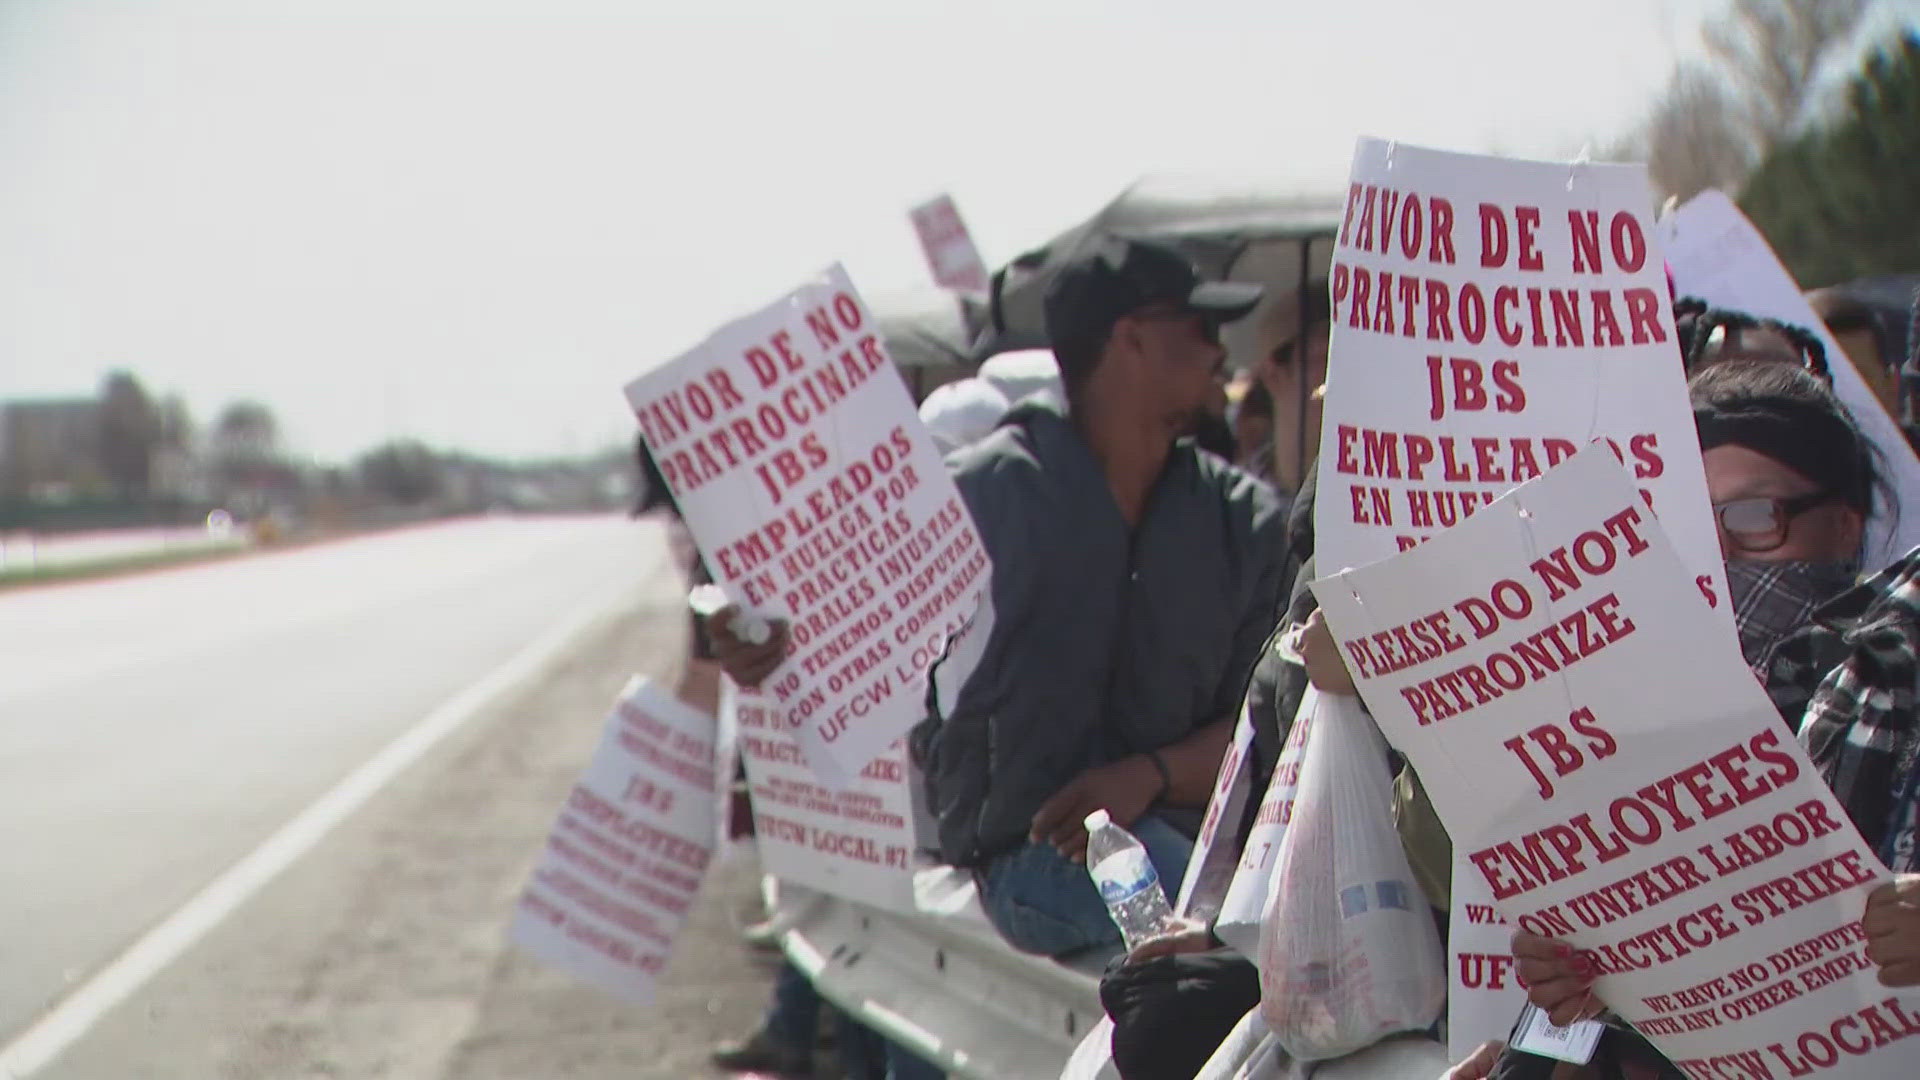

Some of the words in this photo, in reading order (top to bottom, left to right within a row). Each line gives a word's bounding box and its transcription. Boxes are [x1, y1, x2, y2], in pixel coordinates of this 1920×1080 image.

[1341, 182, 1455, 265] FAVOR
[1479, 203, 1544, 272] DE
[1567, 209, 1648, 276] NO
[744, 329, 806, 391] DE
[804, 291, 863, 351] NO
[1332, 262, 1668, 348] PRATROCINAR
[660, 333, 885, 498] PRATROCINAR
[1427, 356, 1527, 421] JBS
[715, 424, 913, 583] EMPLEADOS
[754, 431, 829, 506] JBS
[1336, 424, 1664, 482] EMPLEADS
[742, 570, 777, 607] EN
[781, 502, 873, 583] HUELGA
[874, 464, 919, 513] POR
[1351, 485, 1393, 526] EN
[784, 508, 912, 616] PRACTICAS
[785, 575, 876, 658] ORALES
[875, 498, 962, 587] INJUSTAS
[1343, 608, 1467, 680] PLEASE
[1456, 578, 1533, 640] DO
[1530, 505, 1650, 602] NOT
[773, 671, 800, 703] NO
[801, 602, 893, 676] TENEMOS
[895, 526, 973, 609] DISPUTAS
[788, 686, 825, 728] CON
[828, 638, 892, 694] OTRAS
[895, 549, 986, 645] COMPANIAS
[1400, 592, 1636, 727] PATRONIZE
[817, 675, 892, 744] UFCW
[1503, 706, 1617, 800] JBS
[1469, 728, 1800, 902] EMPLOYEES
[1518, 905, 1577, 938] ON
[1565, 848, 1715, 929] UNFAIR
[1702, 798, 1842, 878] LABOR
[1577, 903, 1740, 976] RACTICE
[1730, 849, 1878, 926] STRIKE
[1632, 1017, 1684, 1037] WITH
[1679, 1008, 1723, 1031] ANY
[1721, 978, 1803, 1021] OTHER
[1797, 945, 1873, 992] EMPL
[1641, 994, 1678, 1015] WE
[1673, 976, 1732, 1009] HAVE
[1727, 962, 1770, 991] NO
[1767, 996, 1920, 1078] LOCAL
